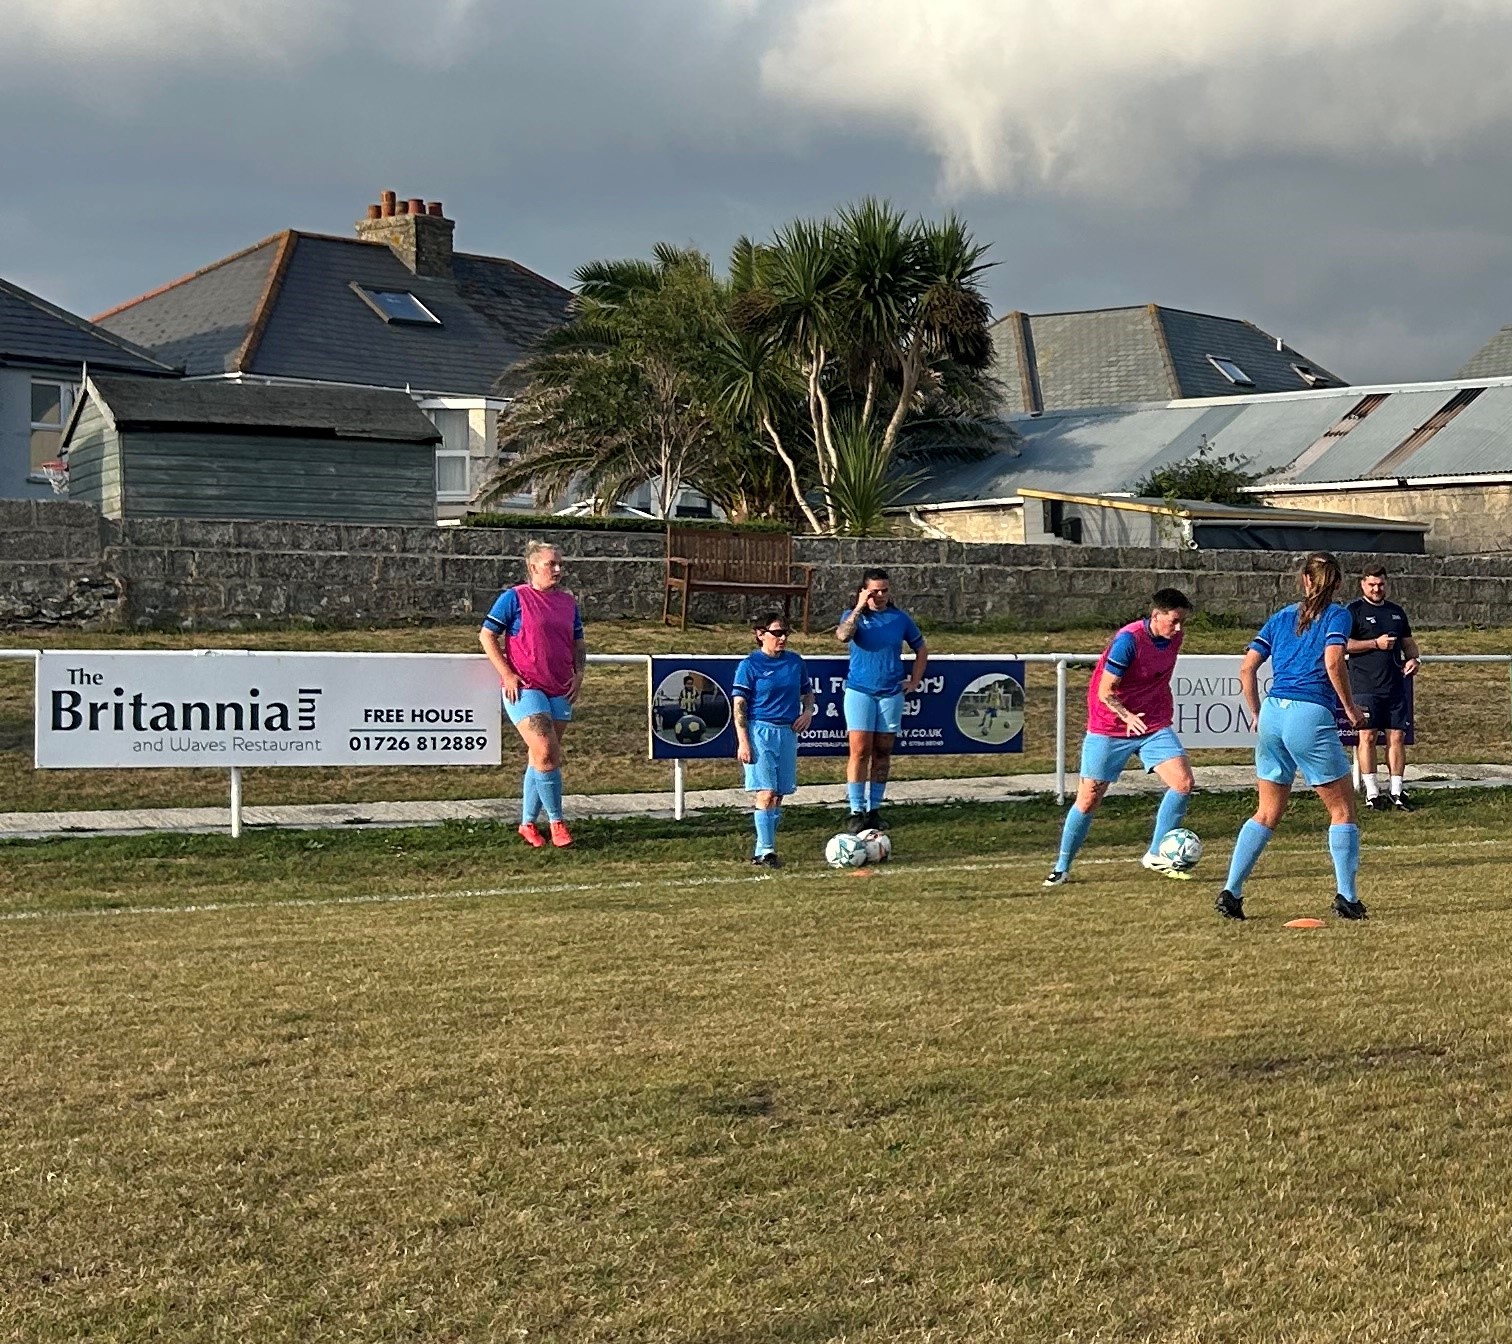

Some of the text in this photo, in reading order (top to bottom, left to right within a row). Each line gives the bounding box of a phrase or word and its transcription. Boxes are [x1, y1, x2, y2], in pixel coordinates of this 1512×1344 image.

[67, 668, 104, 685] The
[1176, 677, 1244, 696] DAVID
[51, 687, 291, 732] Britannia
[298, 688, 322, 731] Inn
[363, 709, 474, 723] FREE HOUSE
[1177, 703, 1258, 734] HOM
[133, 737, 322, 752] and Waves Restaurant
[349, 736, 488, 751] 01726 812889
